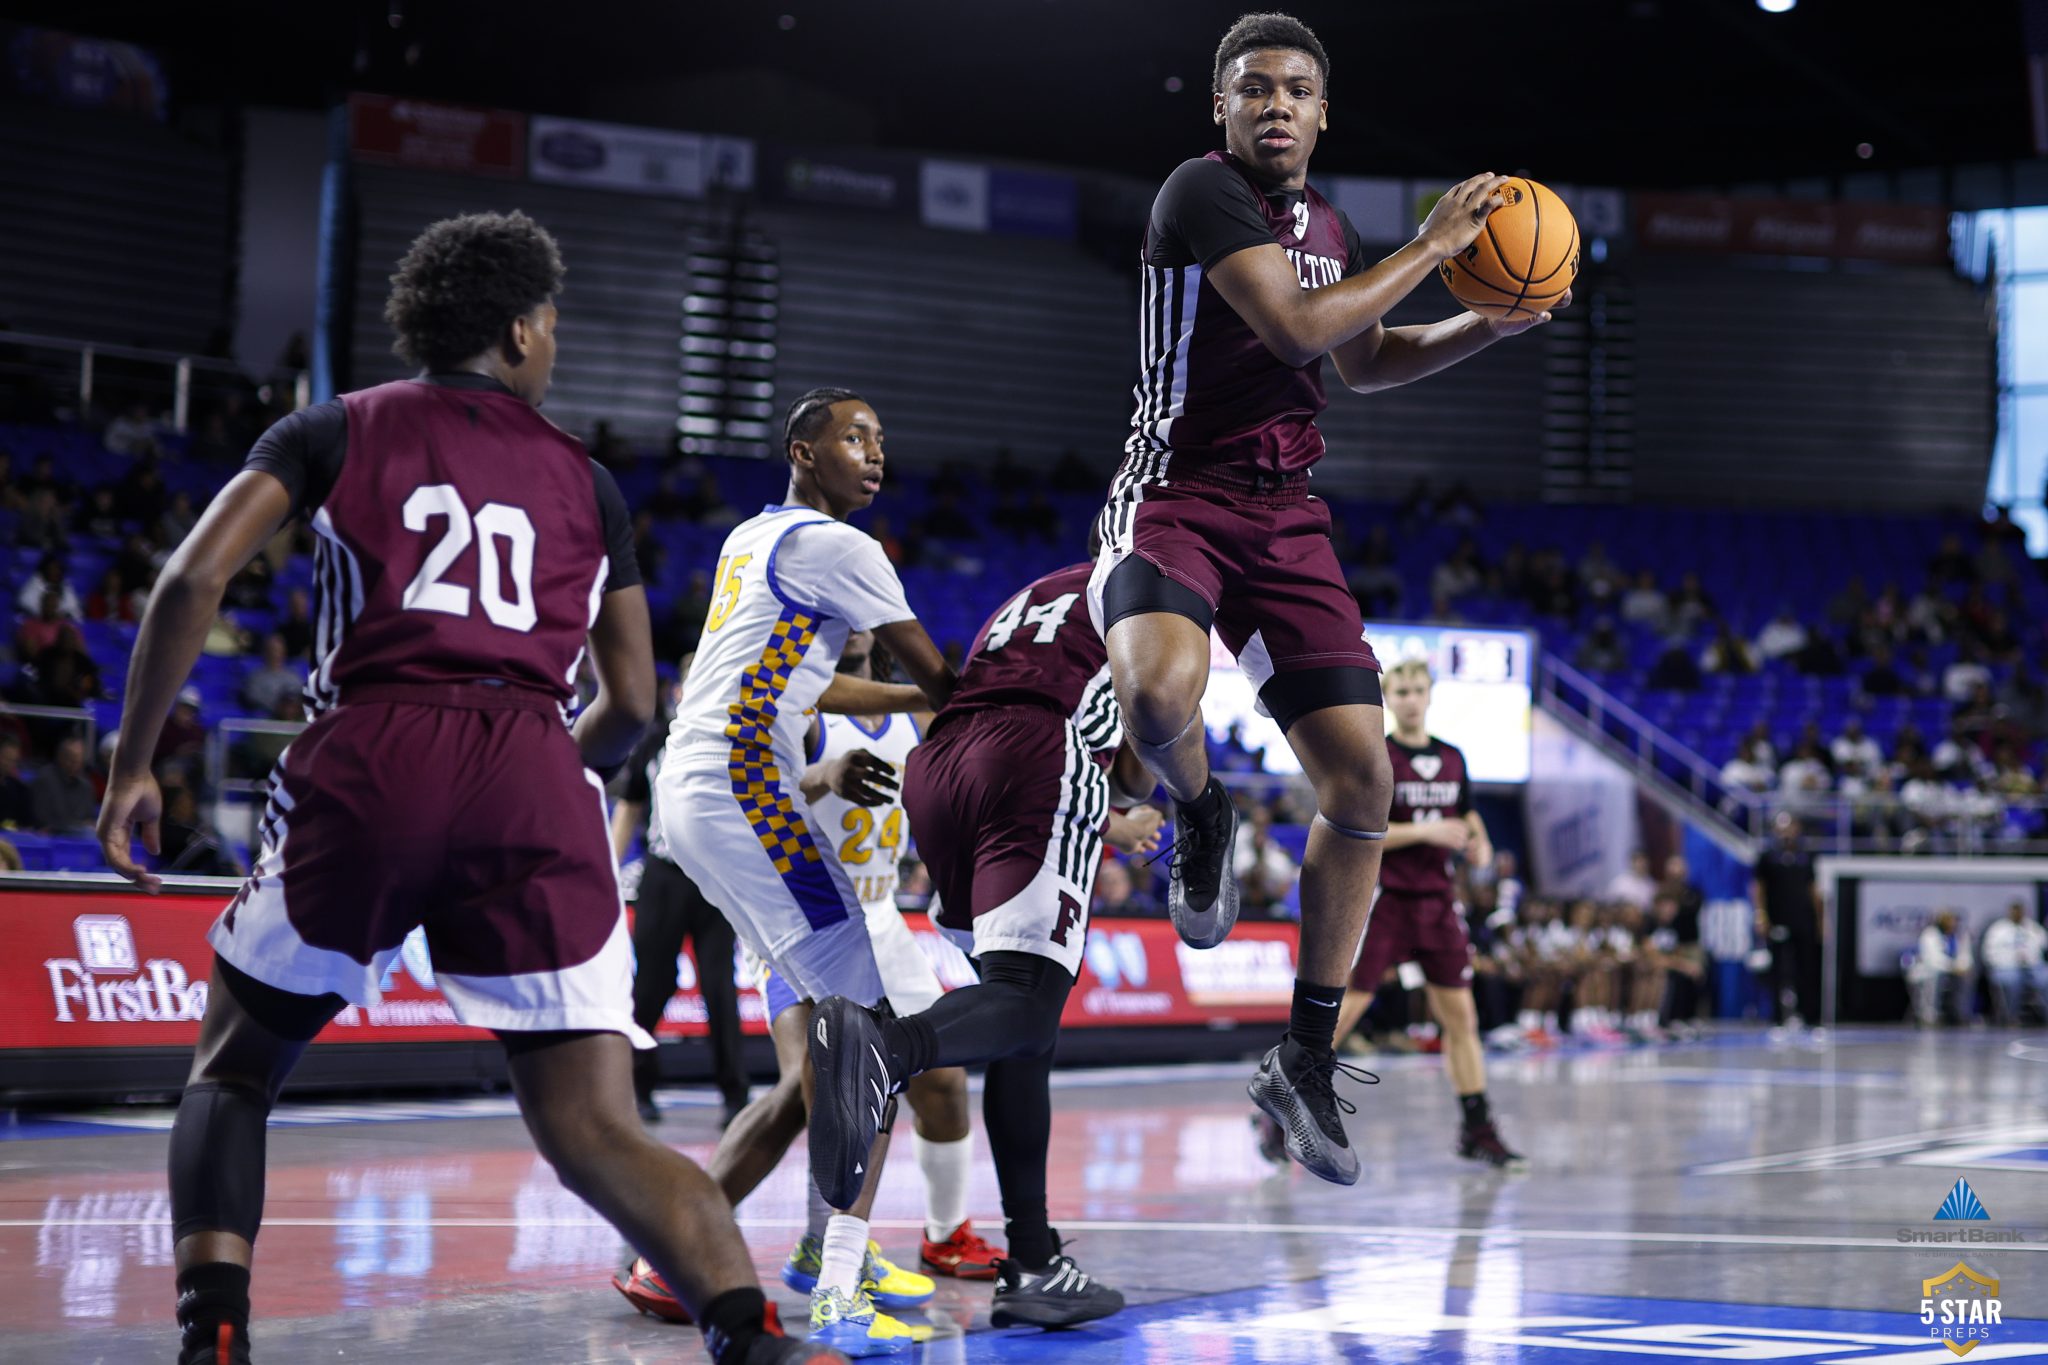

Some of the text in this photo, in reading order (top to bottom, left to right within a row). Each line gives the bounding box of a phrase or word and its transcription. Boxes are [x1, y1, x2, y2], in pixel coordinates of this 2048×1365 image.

[1283, 248, 1342, 289] LTON
[402, 483, 537, 632] 20
[984, 588, 1080, 652] 44
[838, 806, 902, 865] 24
[1049, 890, 1082, 946] F
